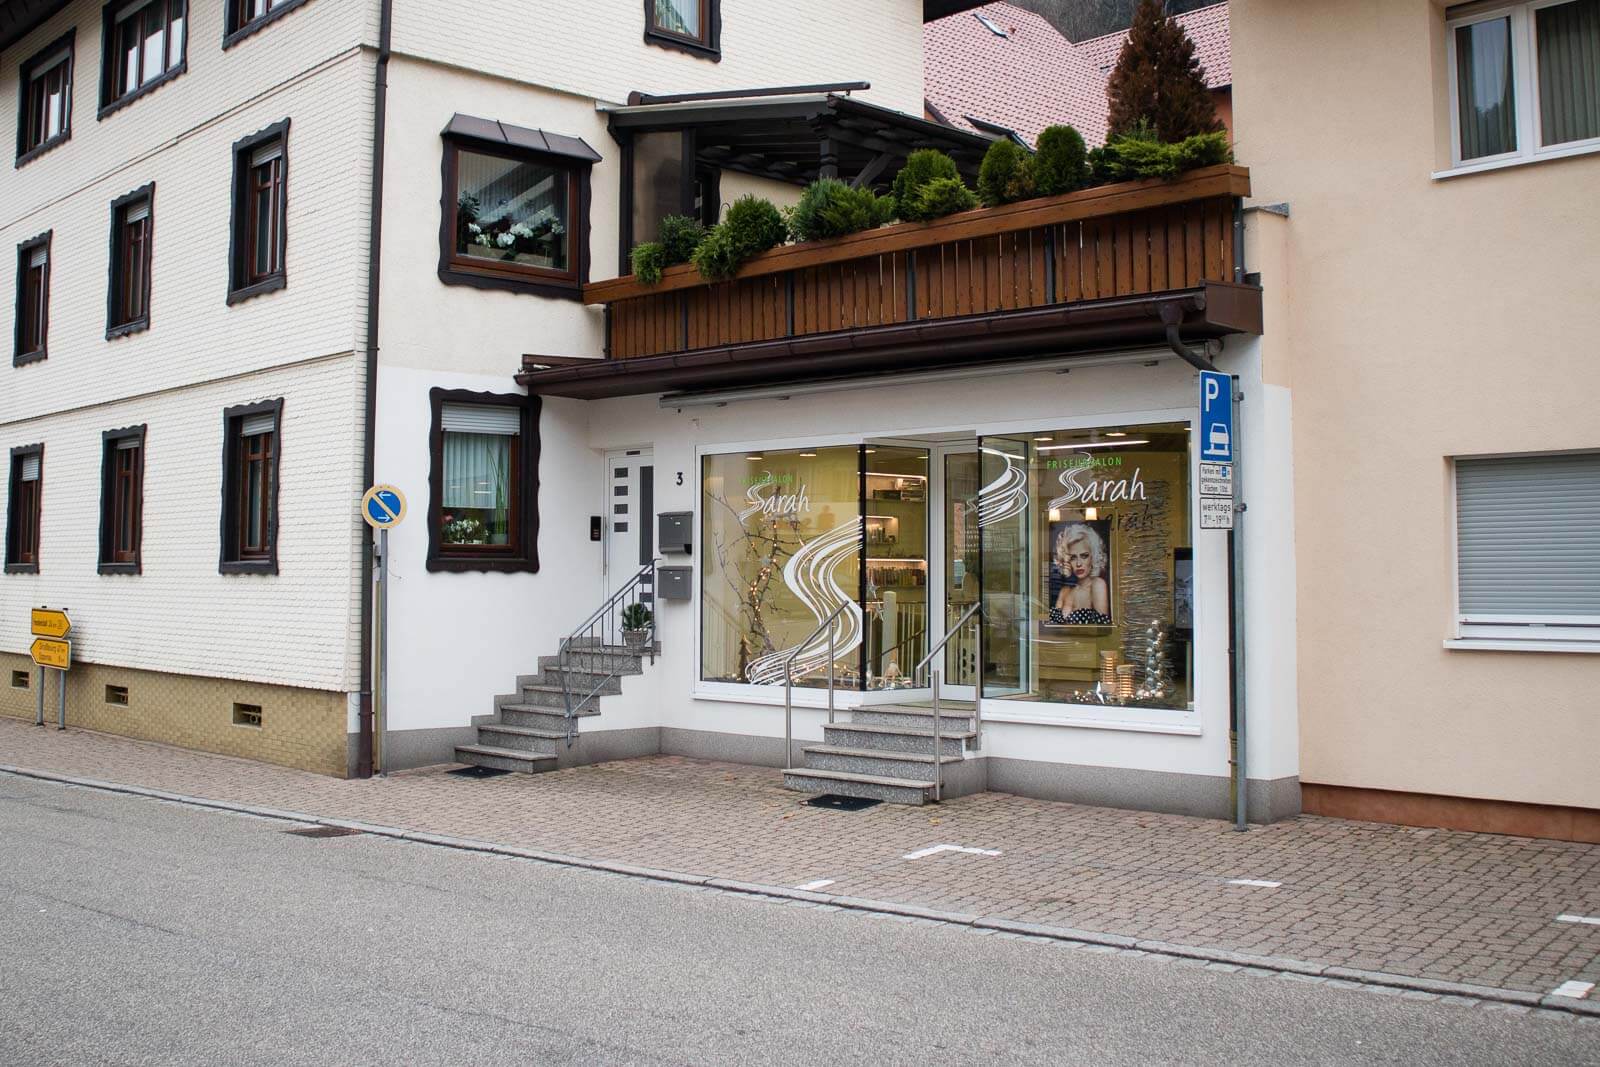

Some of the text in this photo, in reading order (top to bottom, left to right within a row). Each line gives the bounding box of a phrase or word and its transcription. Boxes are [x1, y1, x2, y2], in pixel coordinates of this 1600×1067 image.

[1205, 377, 1219, 412] P
[676, 472, 683, 486] 3
[1048, 452, 1147, 510] Sarah
[738, 471, 811, 526] Sarah
[1202, 503, 1231, 514] werktags
